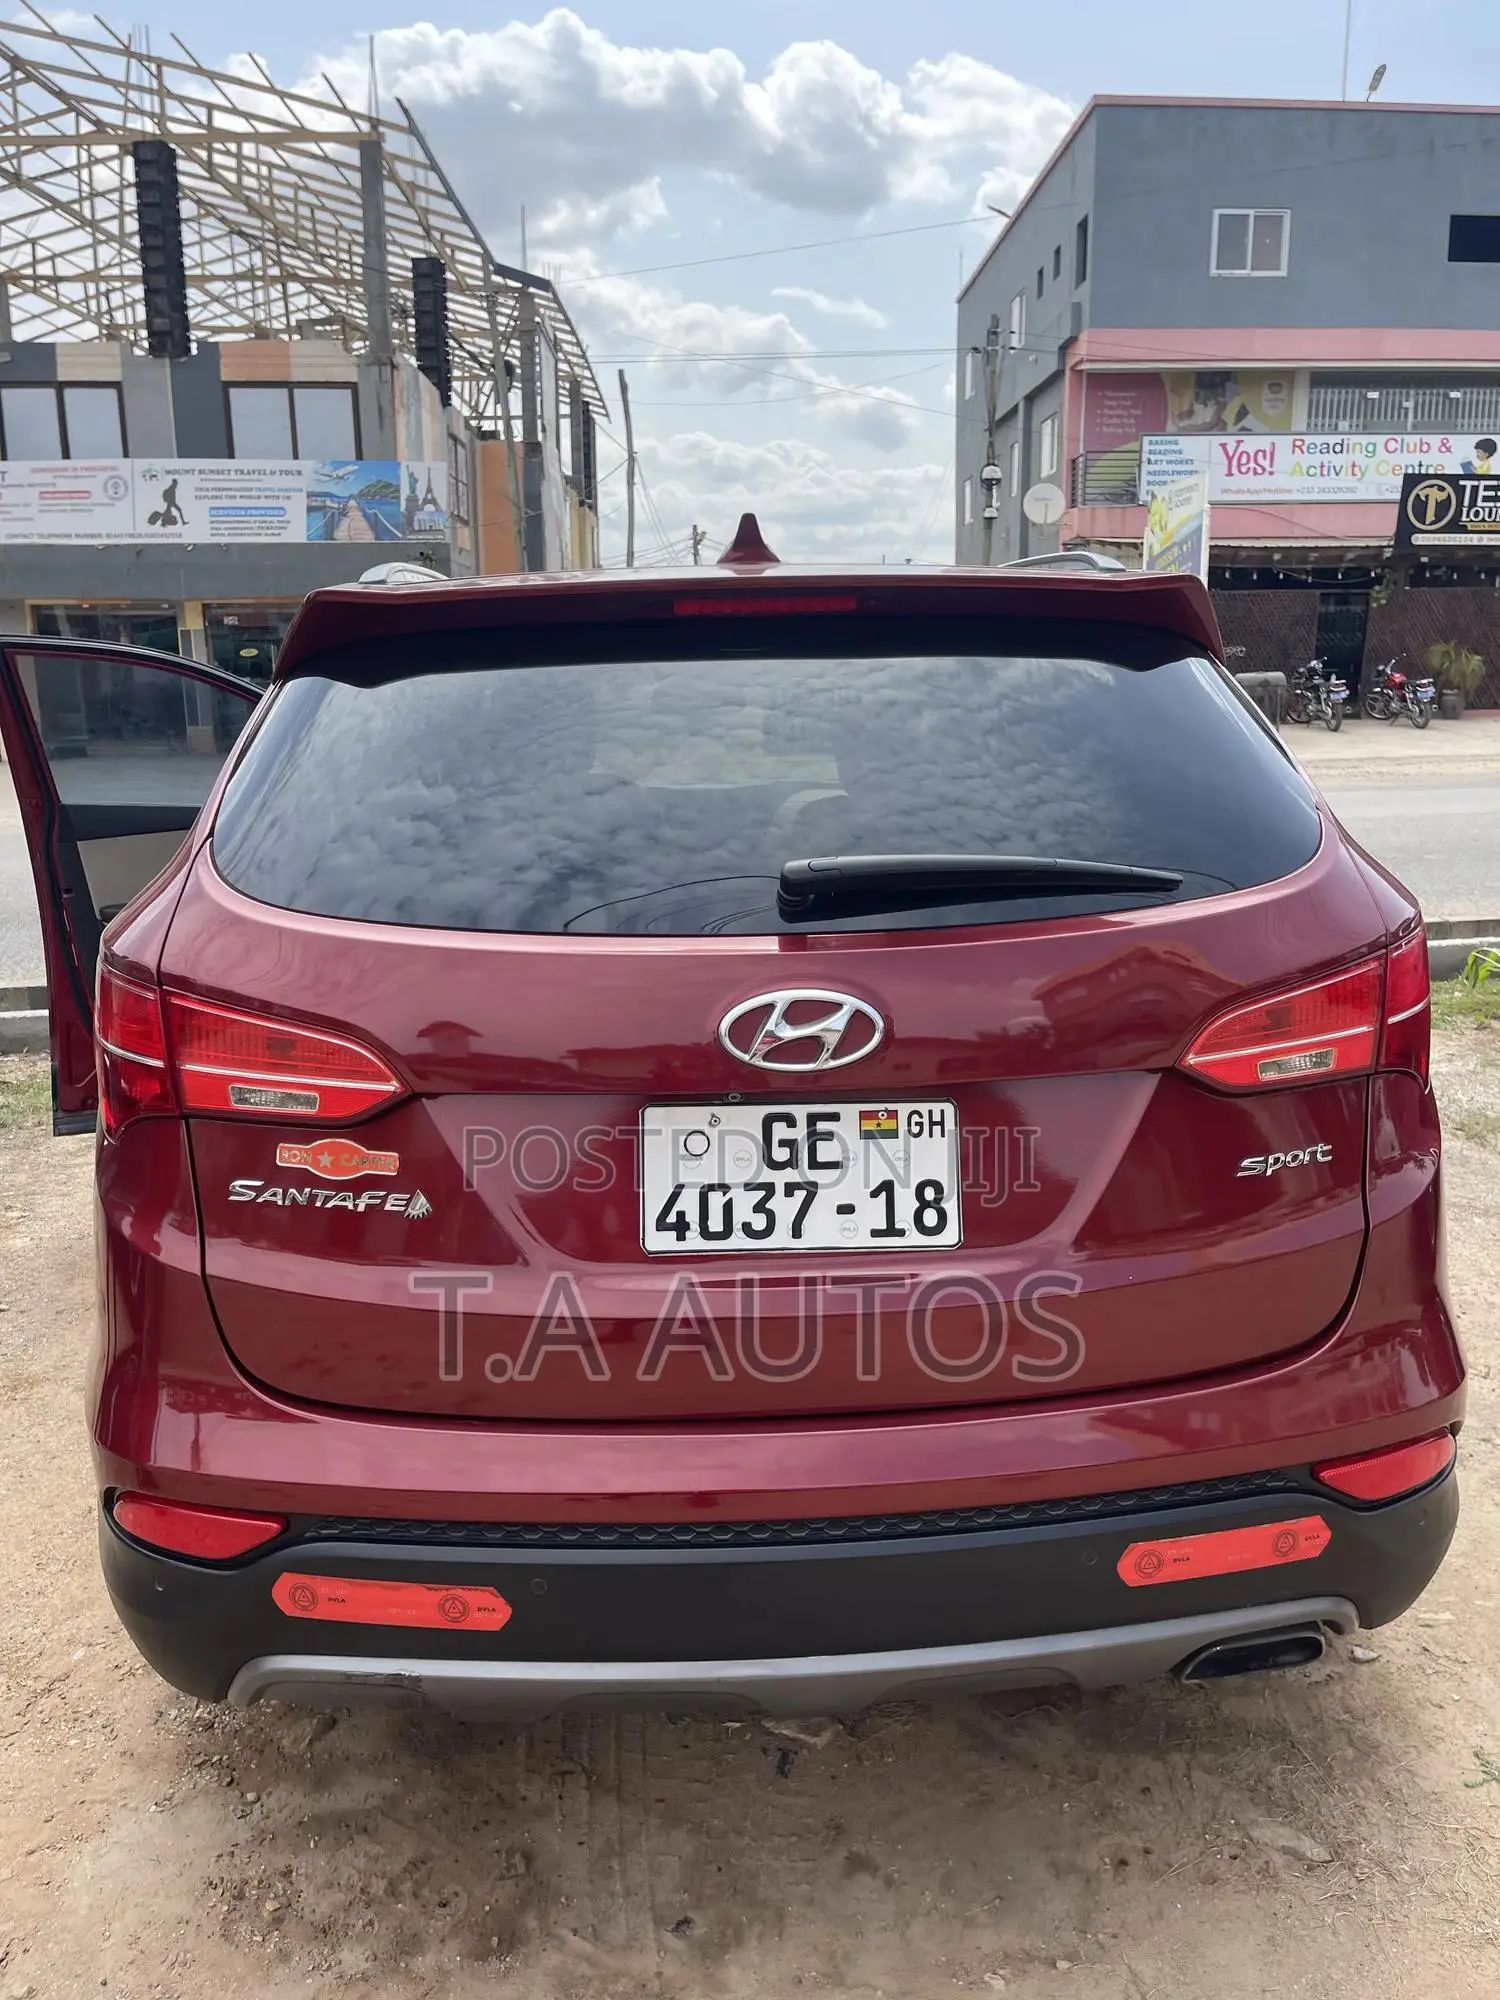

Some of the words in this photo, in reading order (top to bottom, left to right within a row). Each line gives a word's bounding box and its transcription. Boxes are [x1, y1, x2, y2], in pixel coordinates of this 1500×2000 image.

[1218, 439, 1276, 477] Yes!
[1291, 437, 1377, 458] Reading
[1384, 437, 1431, 454] Club
[1438, 438, 1452, 454] &
[164, 468, 196, 476] MOUNT
[198, 468, 232, 476] SUNSET
[234, 468, 268, 476] TRAVEL
[1289, 460, 1373, 480] Activity
[1375, 460, 1446, 475] Centre
[1459, 479, 1500, 507] TE
[762, 1111, 844, 1171] GE
[906, 1108, 946, 1139] GH
[1236, 1143, 1333, 1177] Sport
